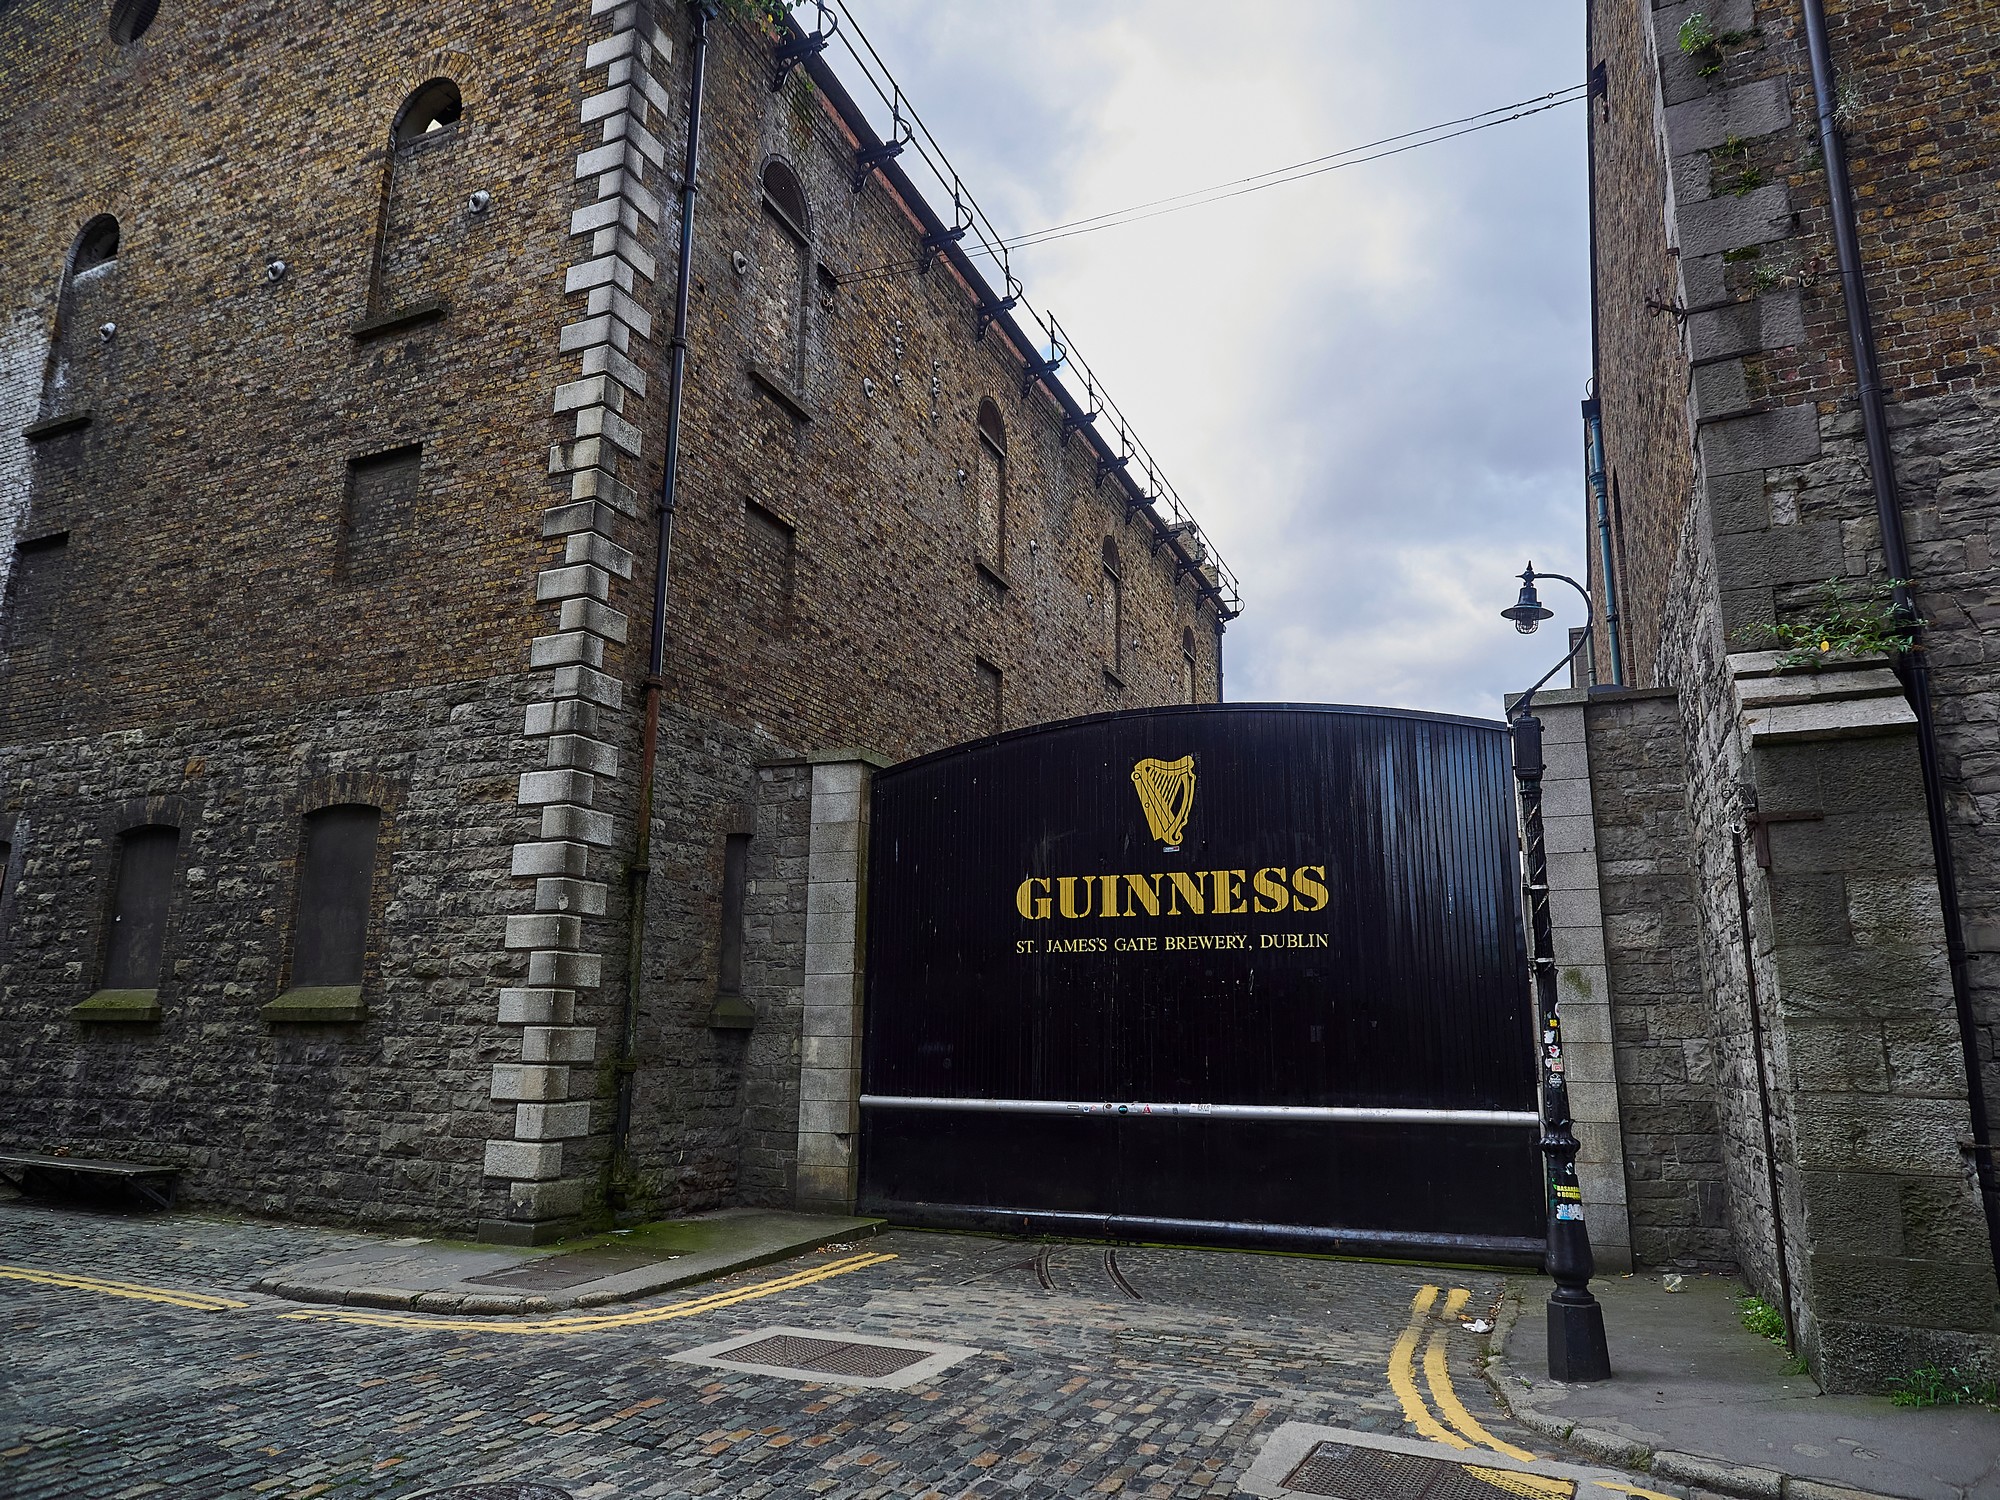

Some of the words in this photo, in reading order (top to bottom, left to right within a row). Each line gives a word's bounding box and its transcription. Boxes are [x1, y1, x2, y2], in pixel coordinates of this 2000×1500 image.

[1016, 865, 1329, 920] GUINNESS
[1016, 940, 1038, 954] ST.
[1046, 938, 1108, 953] JAMES'S
[1114, 937, 1158, 952] GATE
[1164, 935, 1253, 951] BREWERY,
[1260, 933, 1329, 949] DUBLIN
